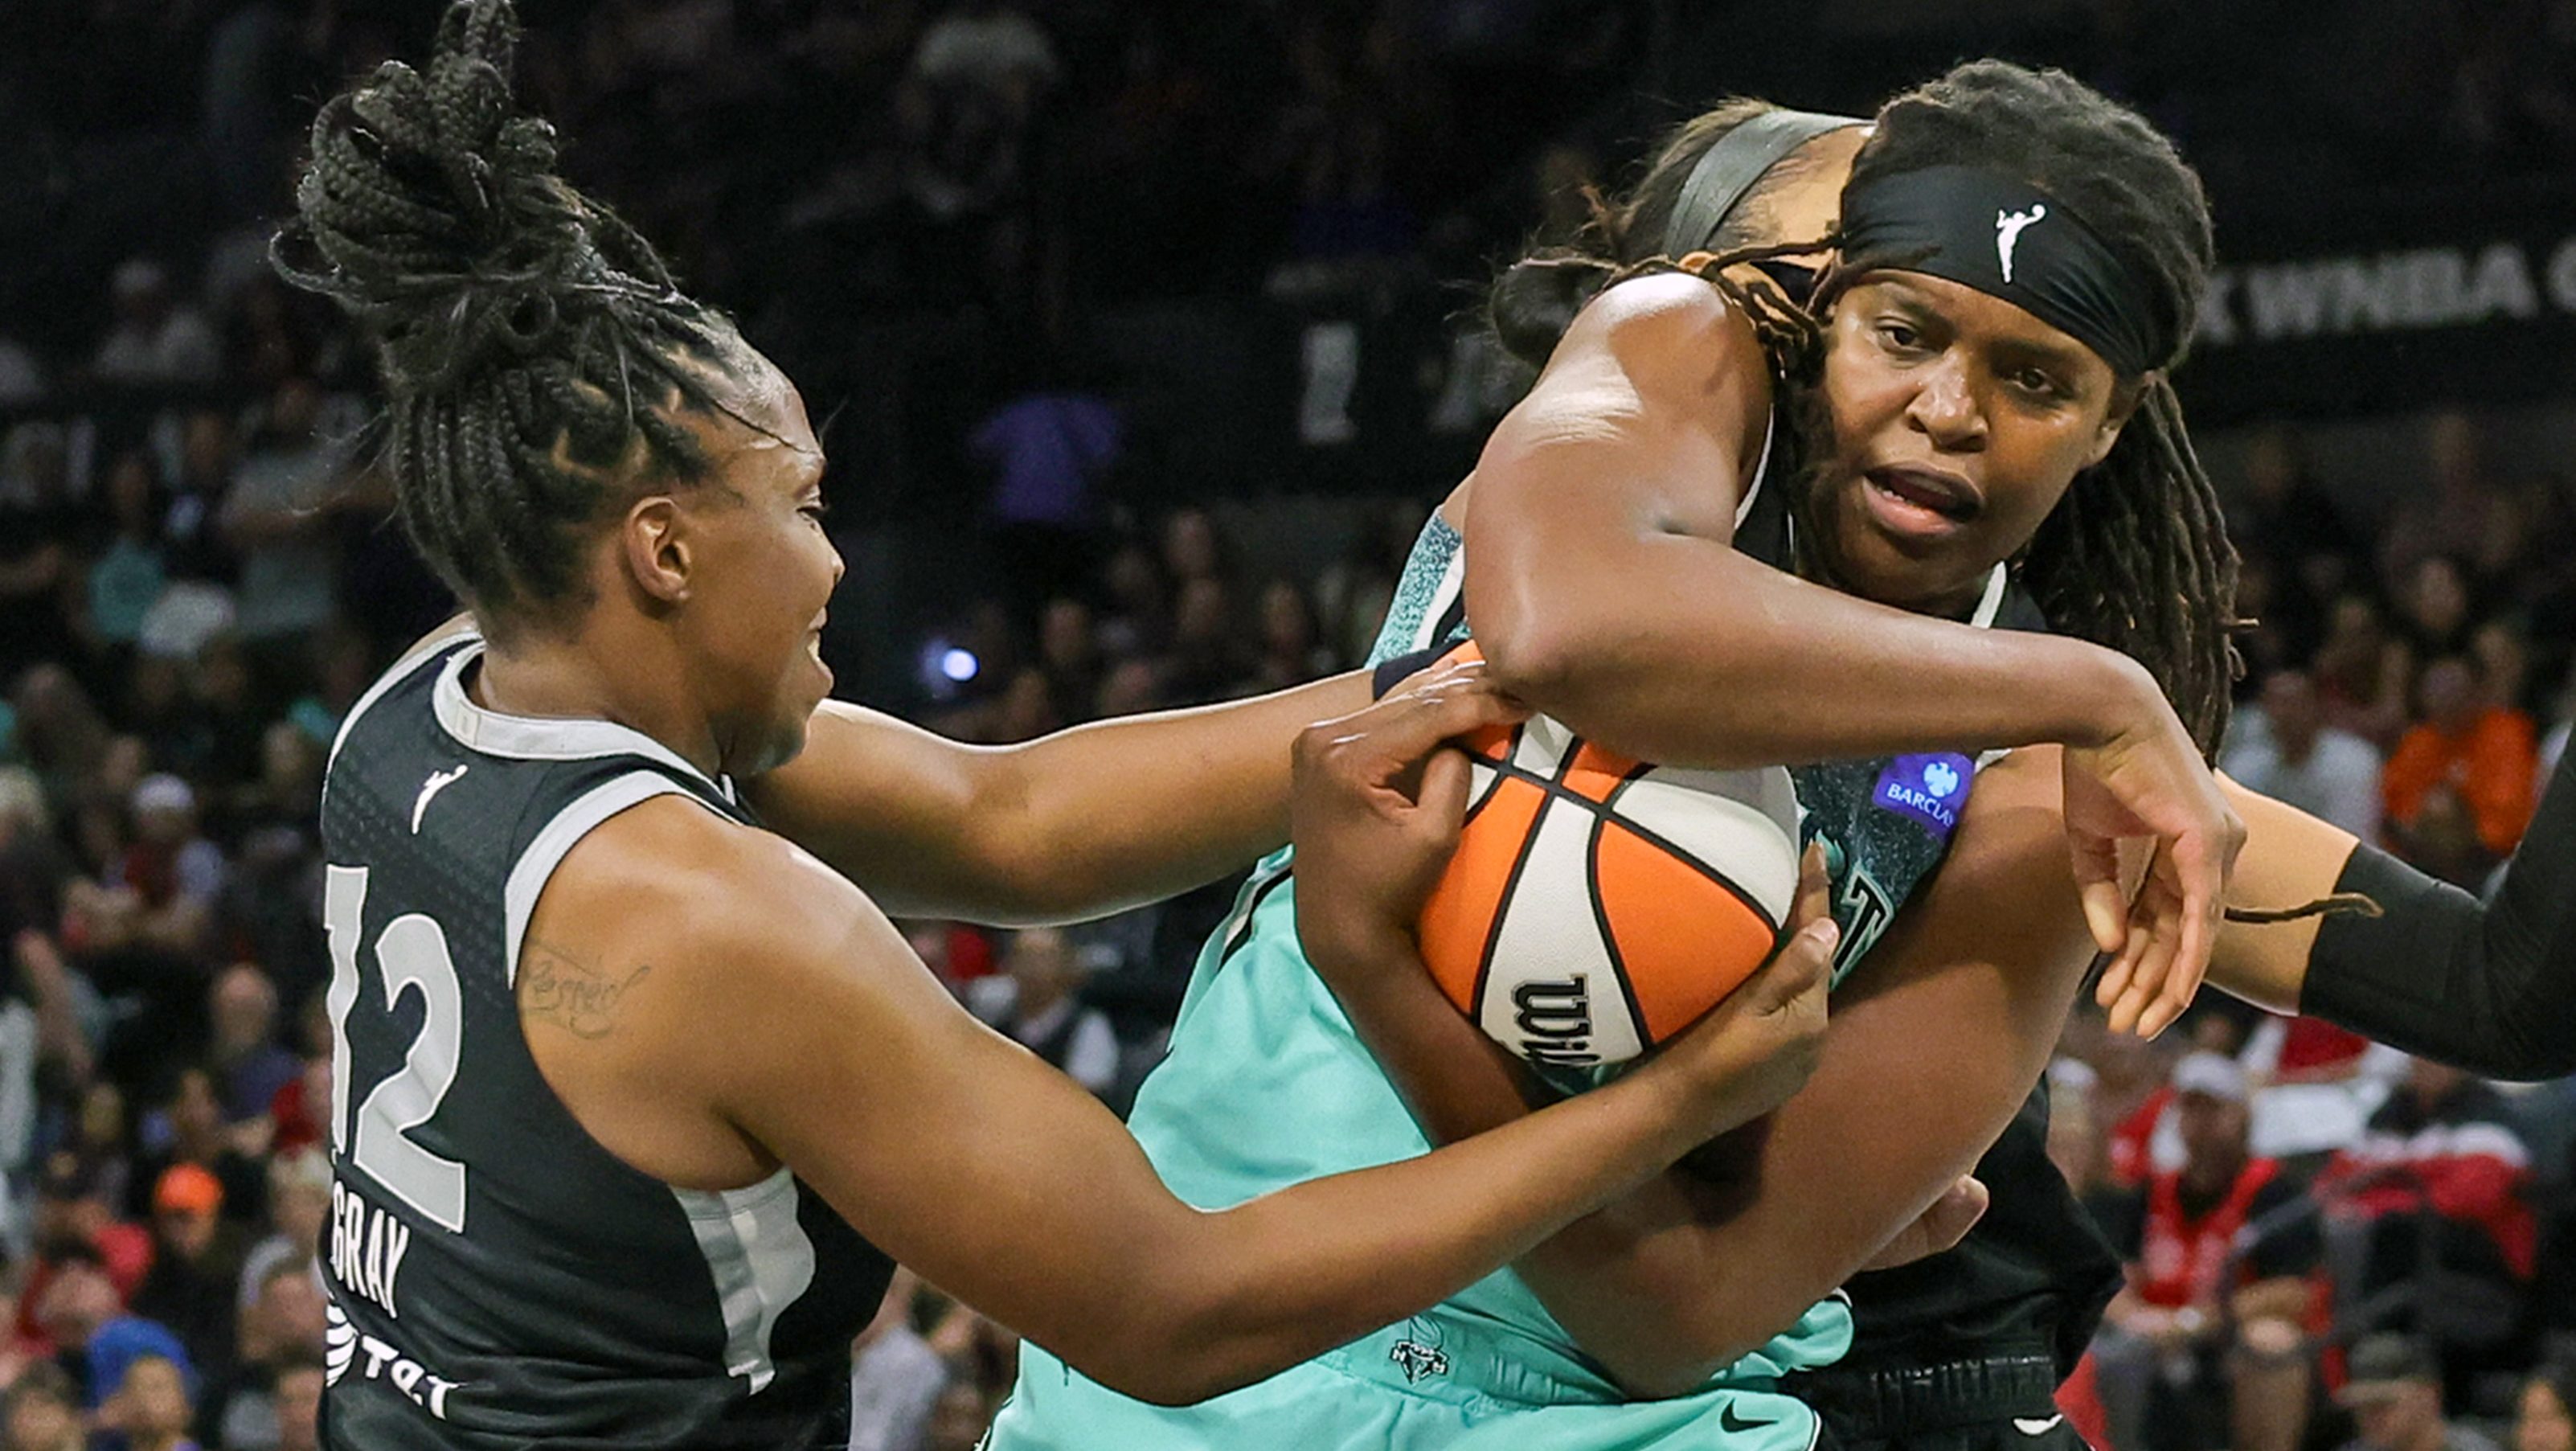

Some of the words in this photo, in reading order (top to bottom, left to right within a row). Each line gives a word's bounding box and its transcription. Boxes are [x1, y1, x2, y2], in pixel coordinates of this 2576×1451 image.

[2250, 244, 2540, 338] WNBA
[1886, 782, 1954, 828] BARCLA
[324, 865, 465, 1234] 12
[330, 1179, 410, 1319] GRAY
